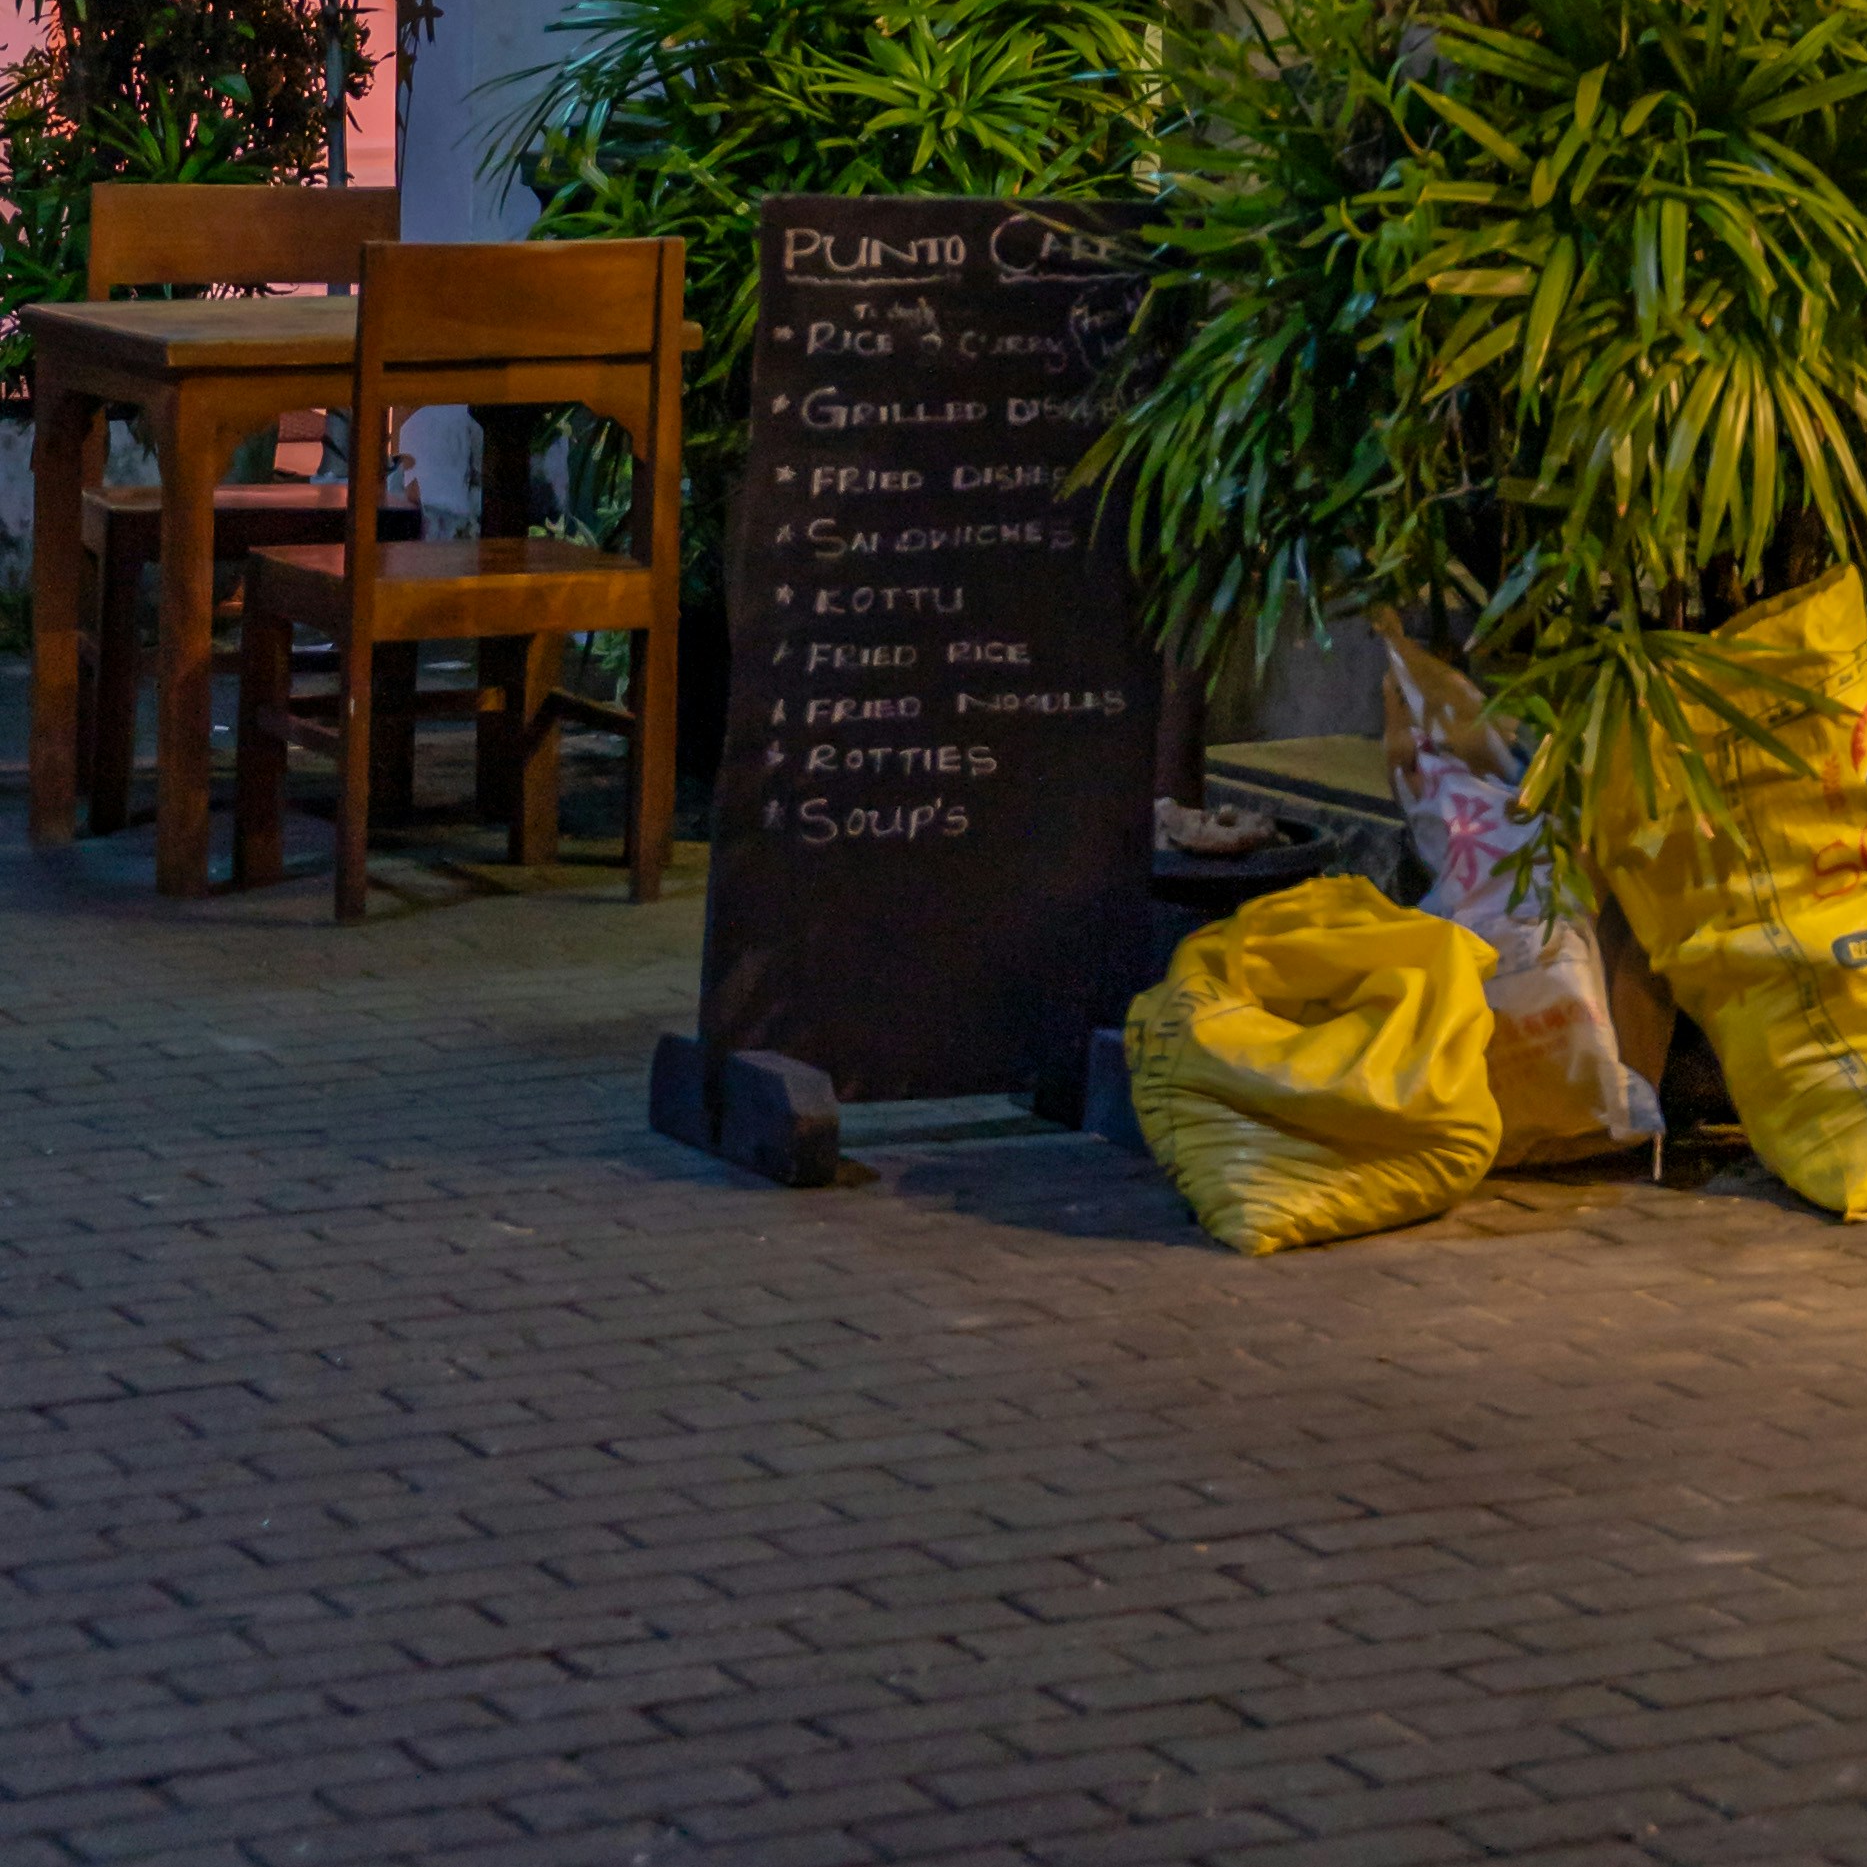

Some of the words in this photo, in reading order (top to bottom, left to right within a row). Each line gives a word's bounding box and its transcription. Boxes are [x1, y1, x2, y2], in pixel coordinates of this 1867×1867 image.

[783, 226, 967, 273] PUNTO
[808, 640, 918, 673] FRIED
[946, 640, 1032, 666] RICE
[806, 696, 921, 725] FRIED
[807, 743, 998, 778] ROTTIES
